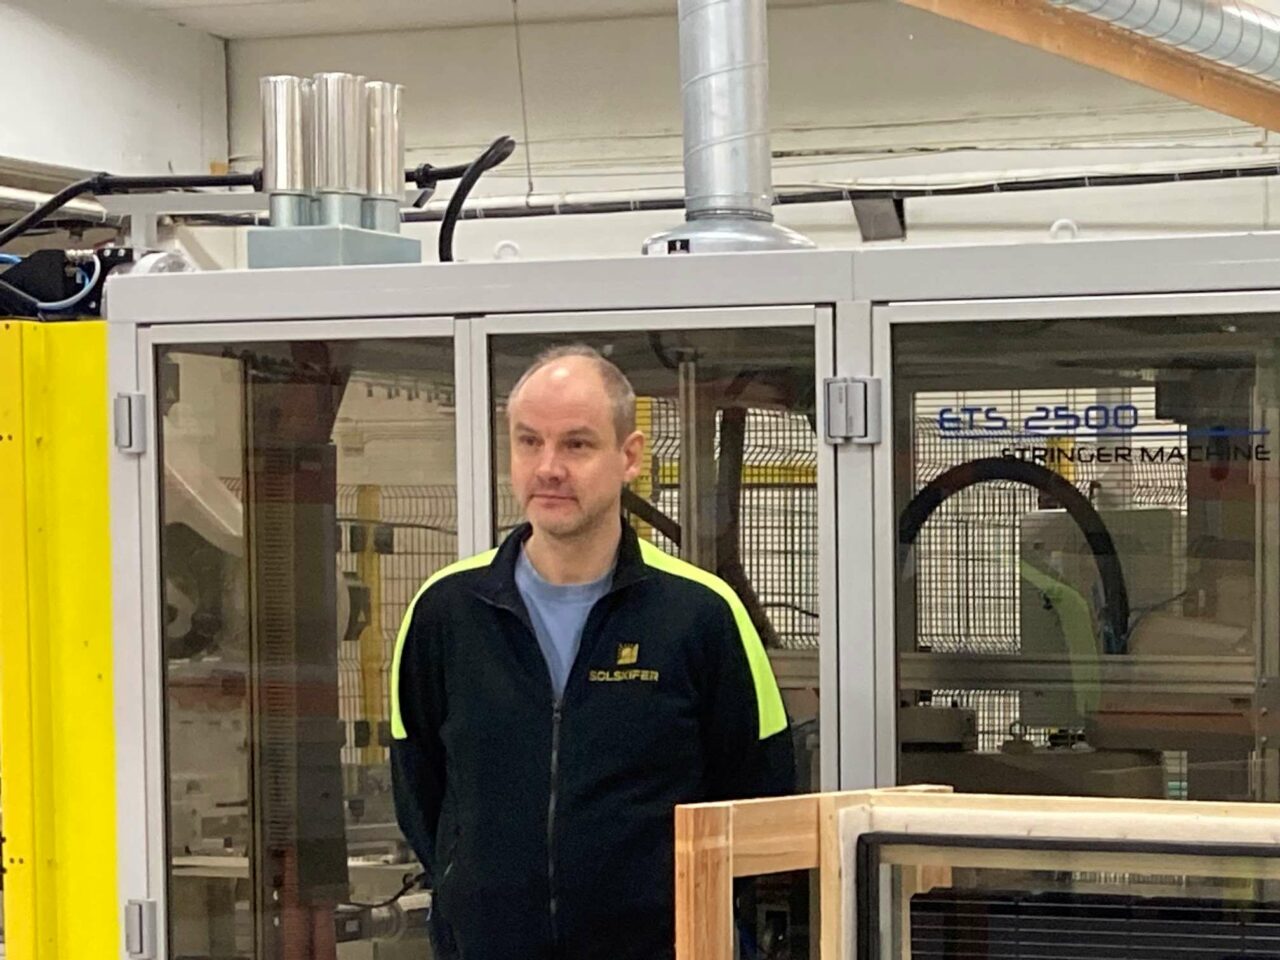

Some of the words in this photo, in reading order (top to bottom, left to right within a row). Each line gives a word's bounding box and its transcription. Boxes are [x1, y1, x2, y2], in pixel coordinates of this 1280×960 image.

[939, 406, 1007, 431] ETS
[1024, 405, 1138, 430] 2500
[1001, 445, 1131, 463] STRINGER
[1140, 444, 1271, 462] MACHINE
[588, 669, 659, 682] SOLSKIFER
